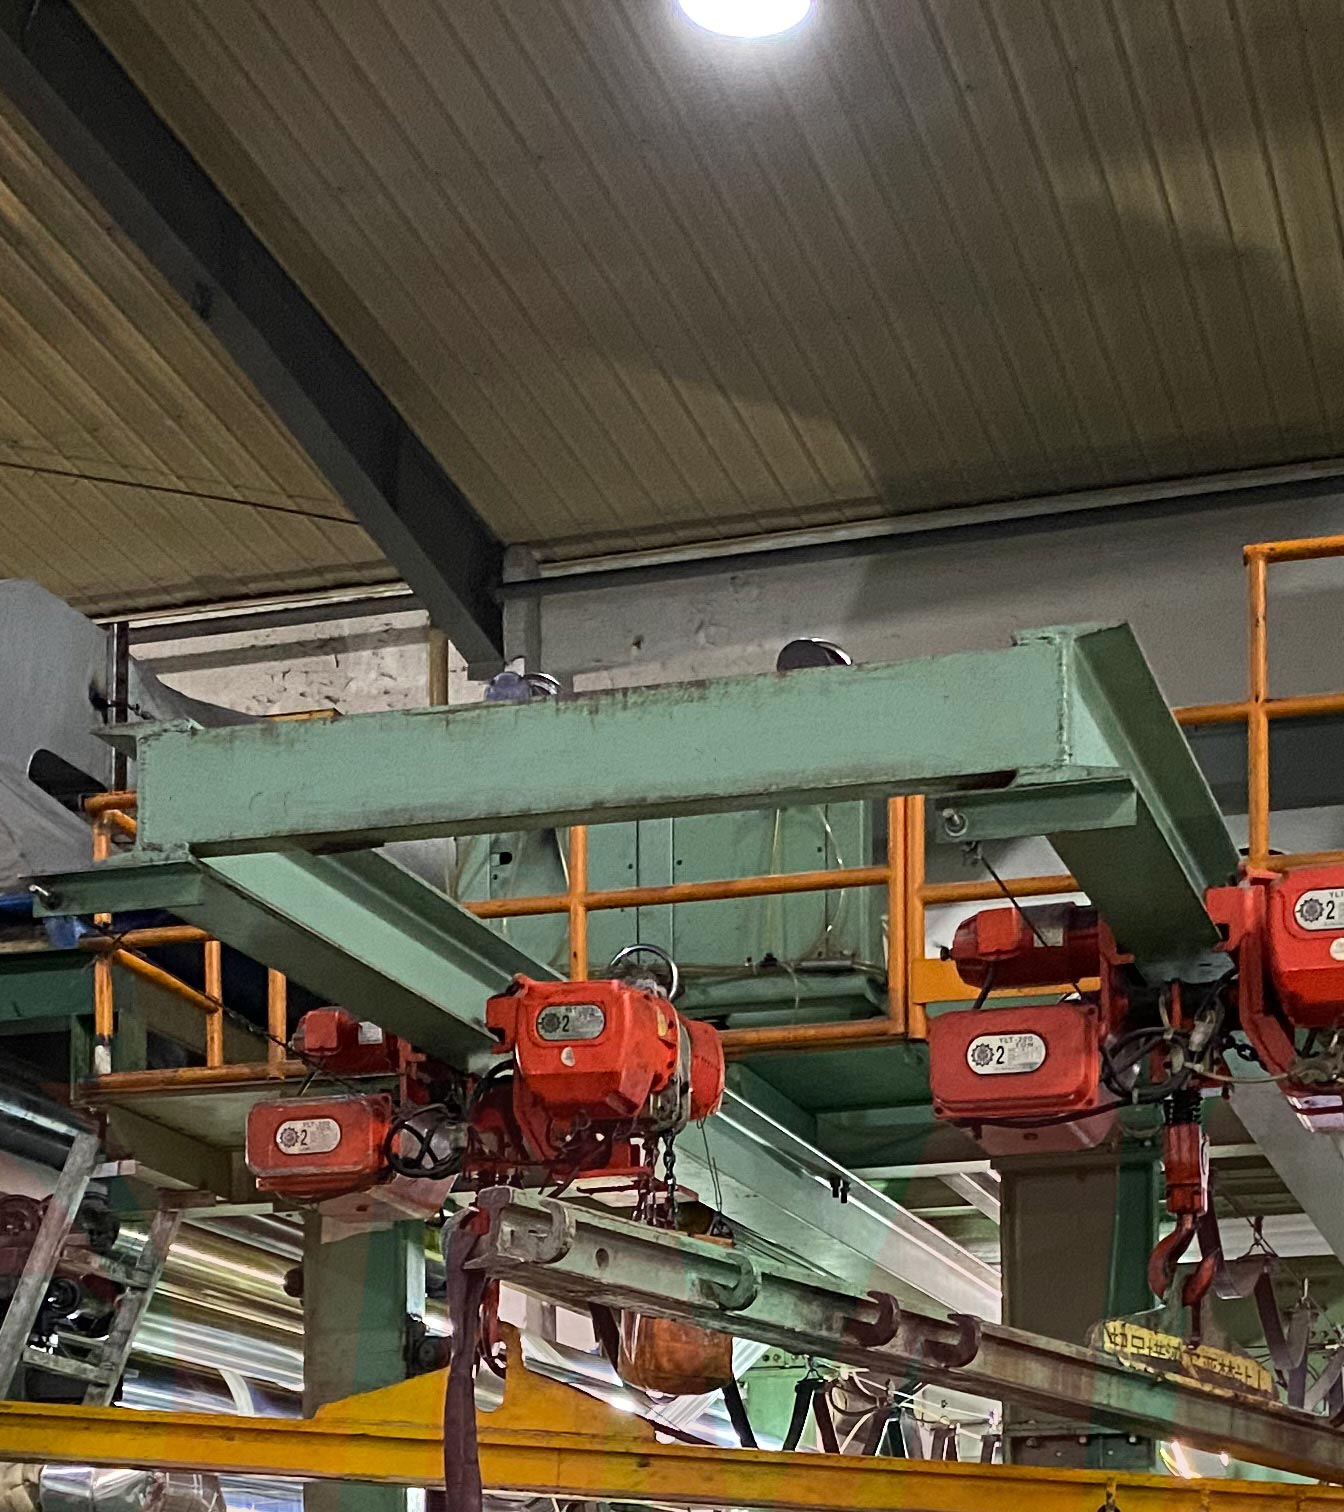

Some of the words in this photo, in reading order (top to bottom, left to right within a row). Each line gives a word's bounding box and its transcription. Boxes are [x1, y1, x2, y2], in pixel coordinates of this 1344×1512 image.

[1326, 900, 1336, 920] 2
[562, 1015, 570, 1032] 2
[996, 1046, 1005, 1065] 2
[300, 1129, 308, 1146] 2
